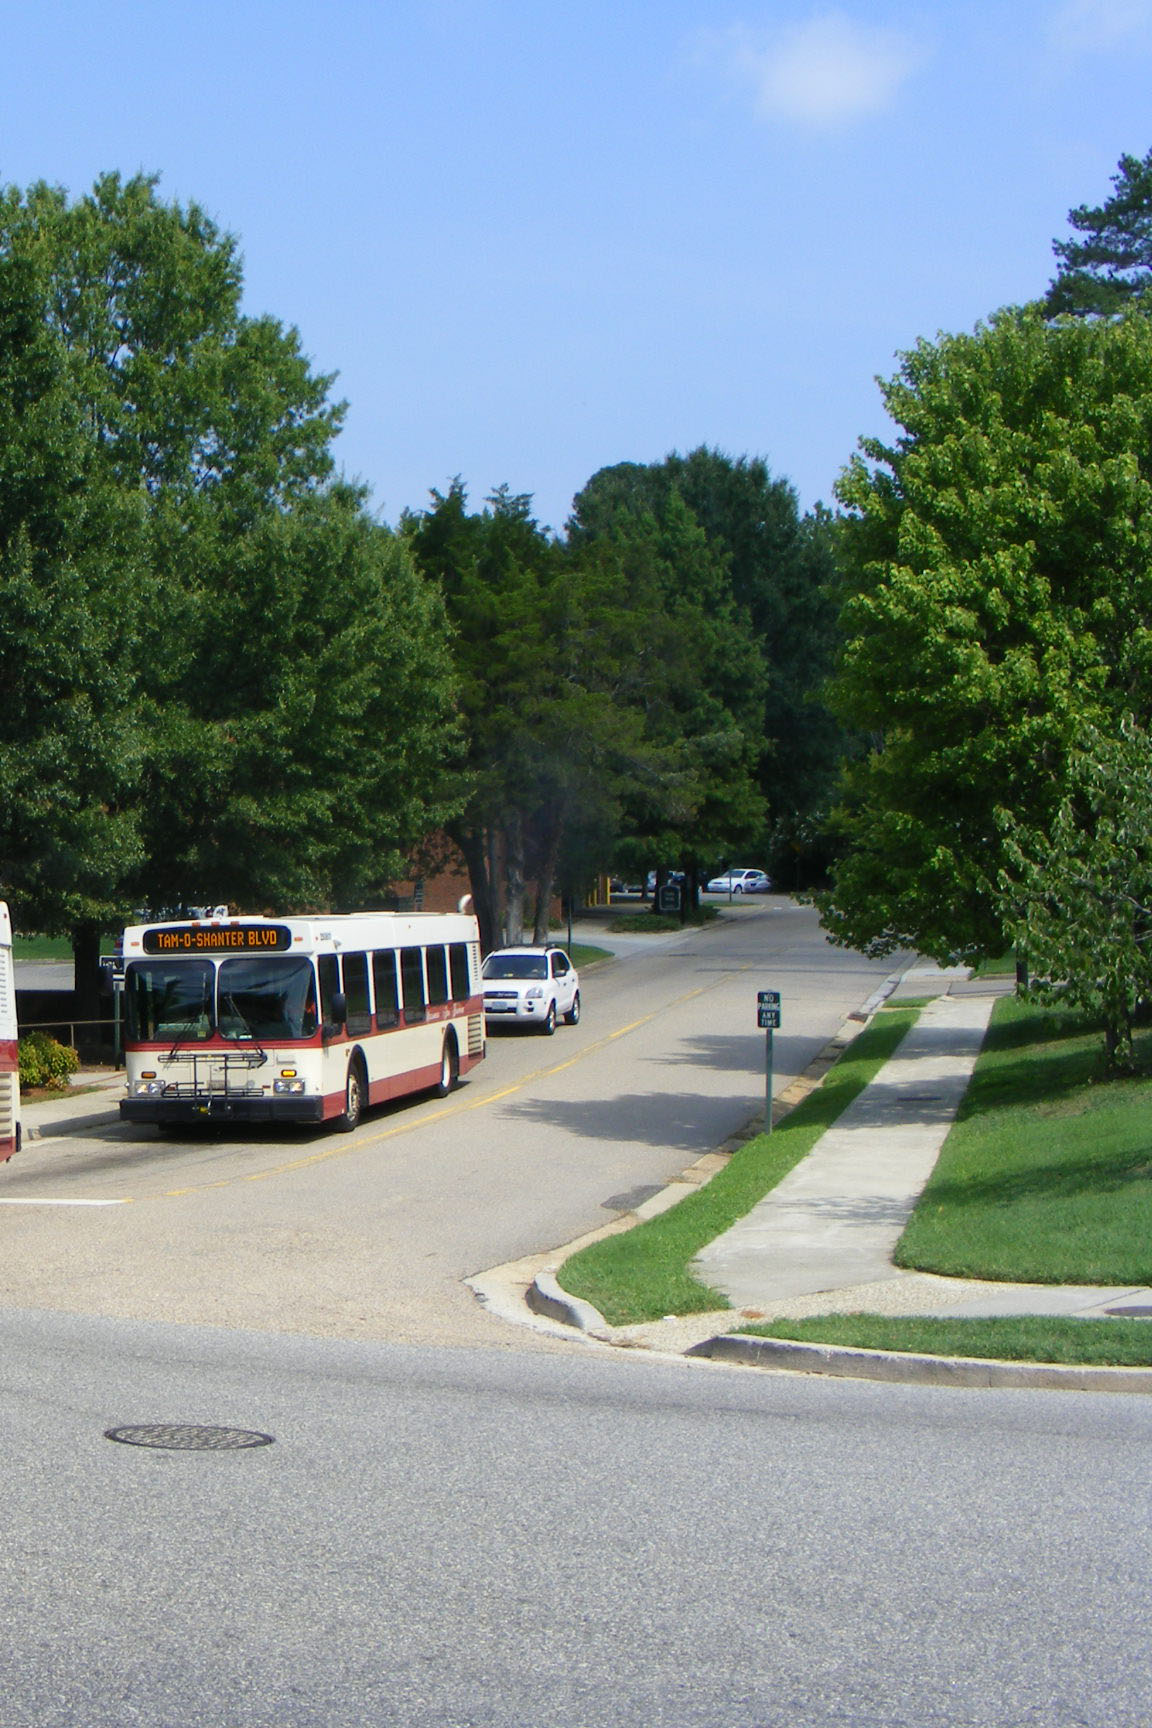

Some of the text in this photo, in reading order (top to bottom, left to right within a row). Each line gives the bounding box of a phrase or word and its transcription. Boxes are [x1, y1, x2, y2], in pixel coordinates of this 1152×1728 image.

[248, 930, 277, 945] BLVD
[763, 993, 774, 1003] NO
[762, 1011, 776, 1019] ANY
[761, 1019, 777, 1027] TIME
